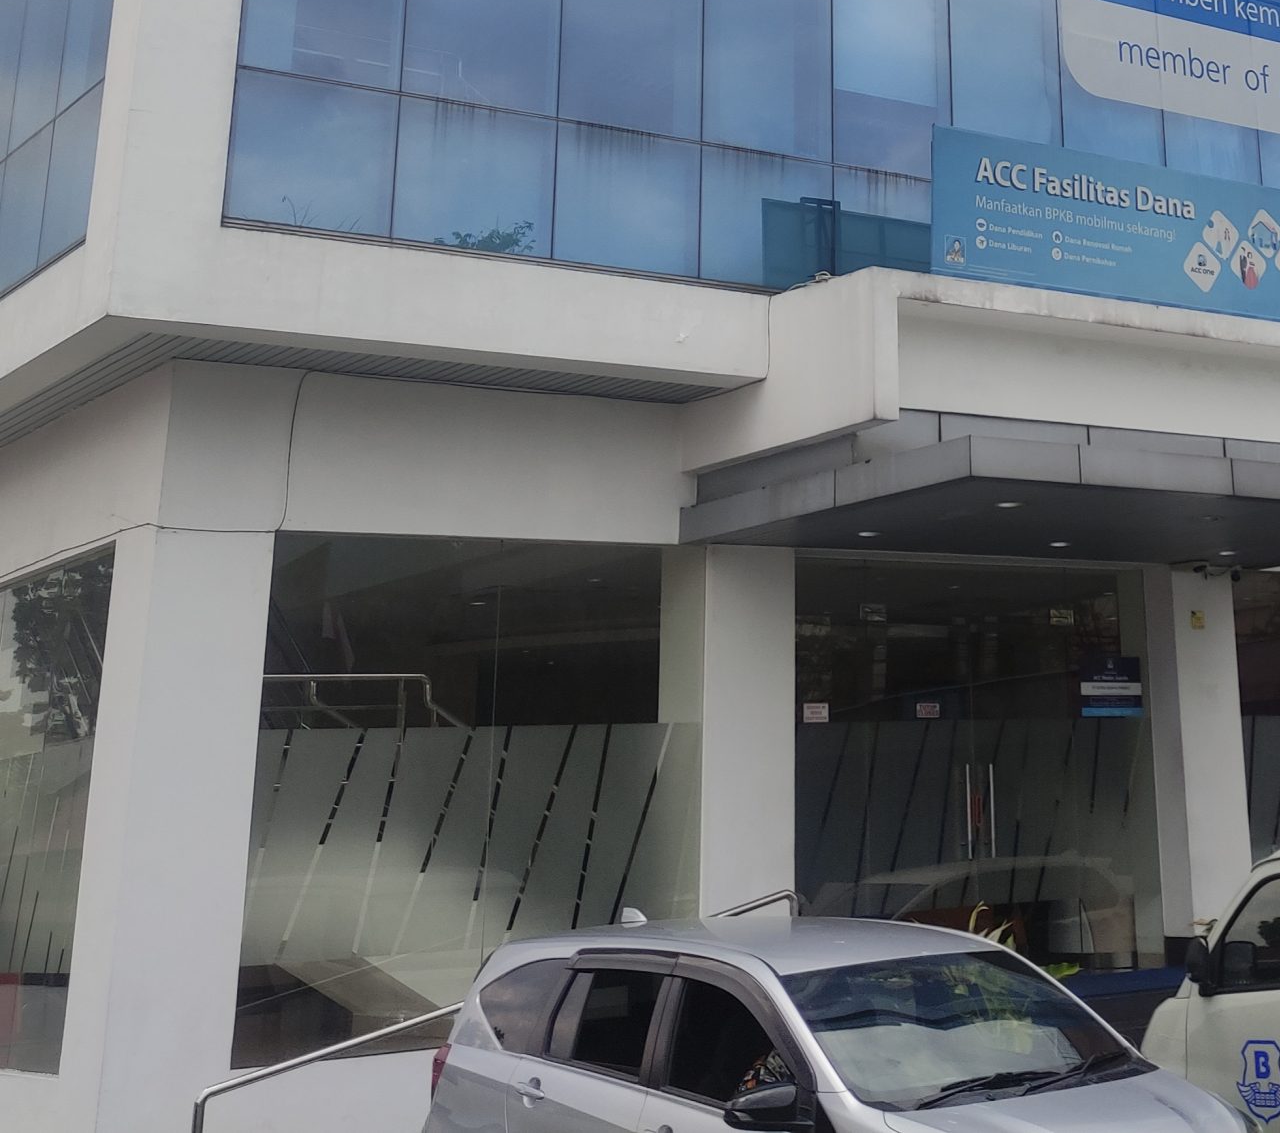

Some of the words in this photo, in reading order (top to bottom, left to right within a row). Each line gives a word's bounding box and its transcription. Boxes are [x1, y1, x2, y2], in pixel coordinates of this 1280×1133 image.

[1118, 39, 1231, 85] member
[1244, 65, 1270, 94] of
[975, 156, 1028, 190] ACC
[1033, 165, 1131, 208] Fasilitas
[1135, 185, 1196, 220] Dana
[975, 195, 1043, 218] Manfaatkan
[1045, 206, 1074, 224] BPKB
[1076, 214, 1125, 232] mobilmu
[1126, 221, 1176, 243] sekarang!
[988, 223, 1006, 233] Dana
[988, 239, 1006, 249] Dana
[1254, 1051, 1271, 1079] B
